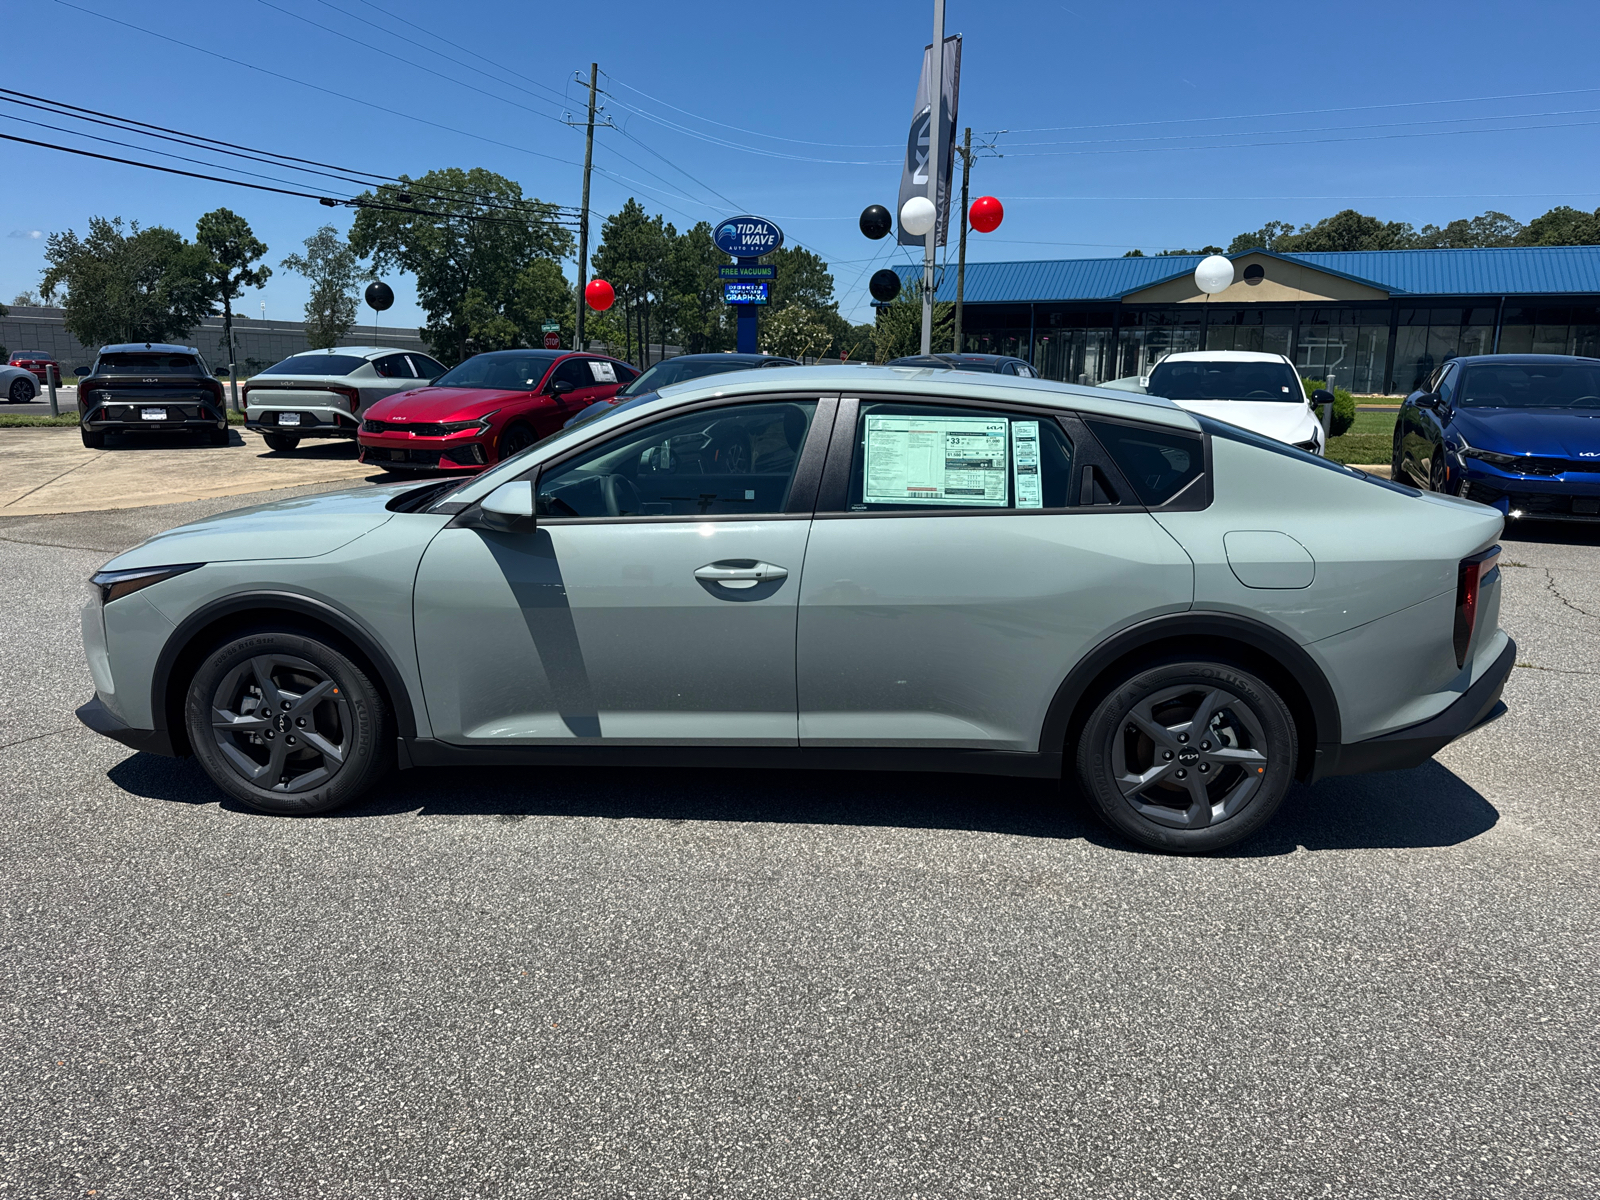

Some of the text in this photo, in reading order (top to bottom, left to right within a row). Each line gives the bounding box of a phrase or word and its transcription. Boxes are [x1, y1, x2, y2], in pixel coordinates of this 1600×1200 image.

[737, 223, 769, 234] TIDAL
[742, 235, 775, 245] WAVE
[950, 437, 960, 445] 33
[1189, 667, 1249, 689] SOLUS
[354, 699, 370, 757] KUMHO
